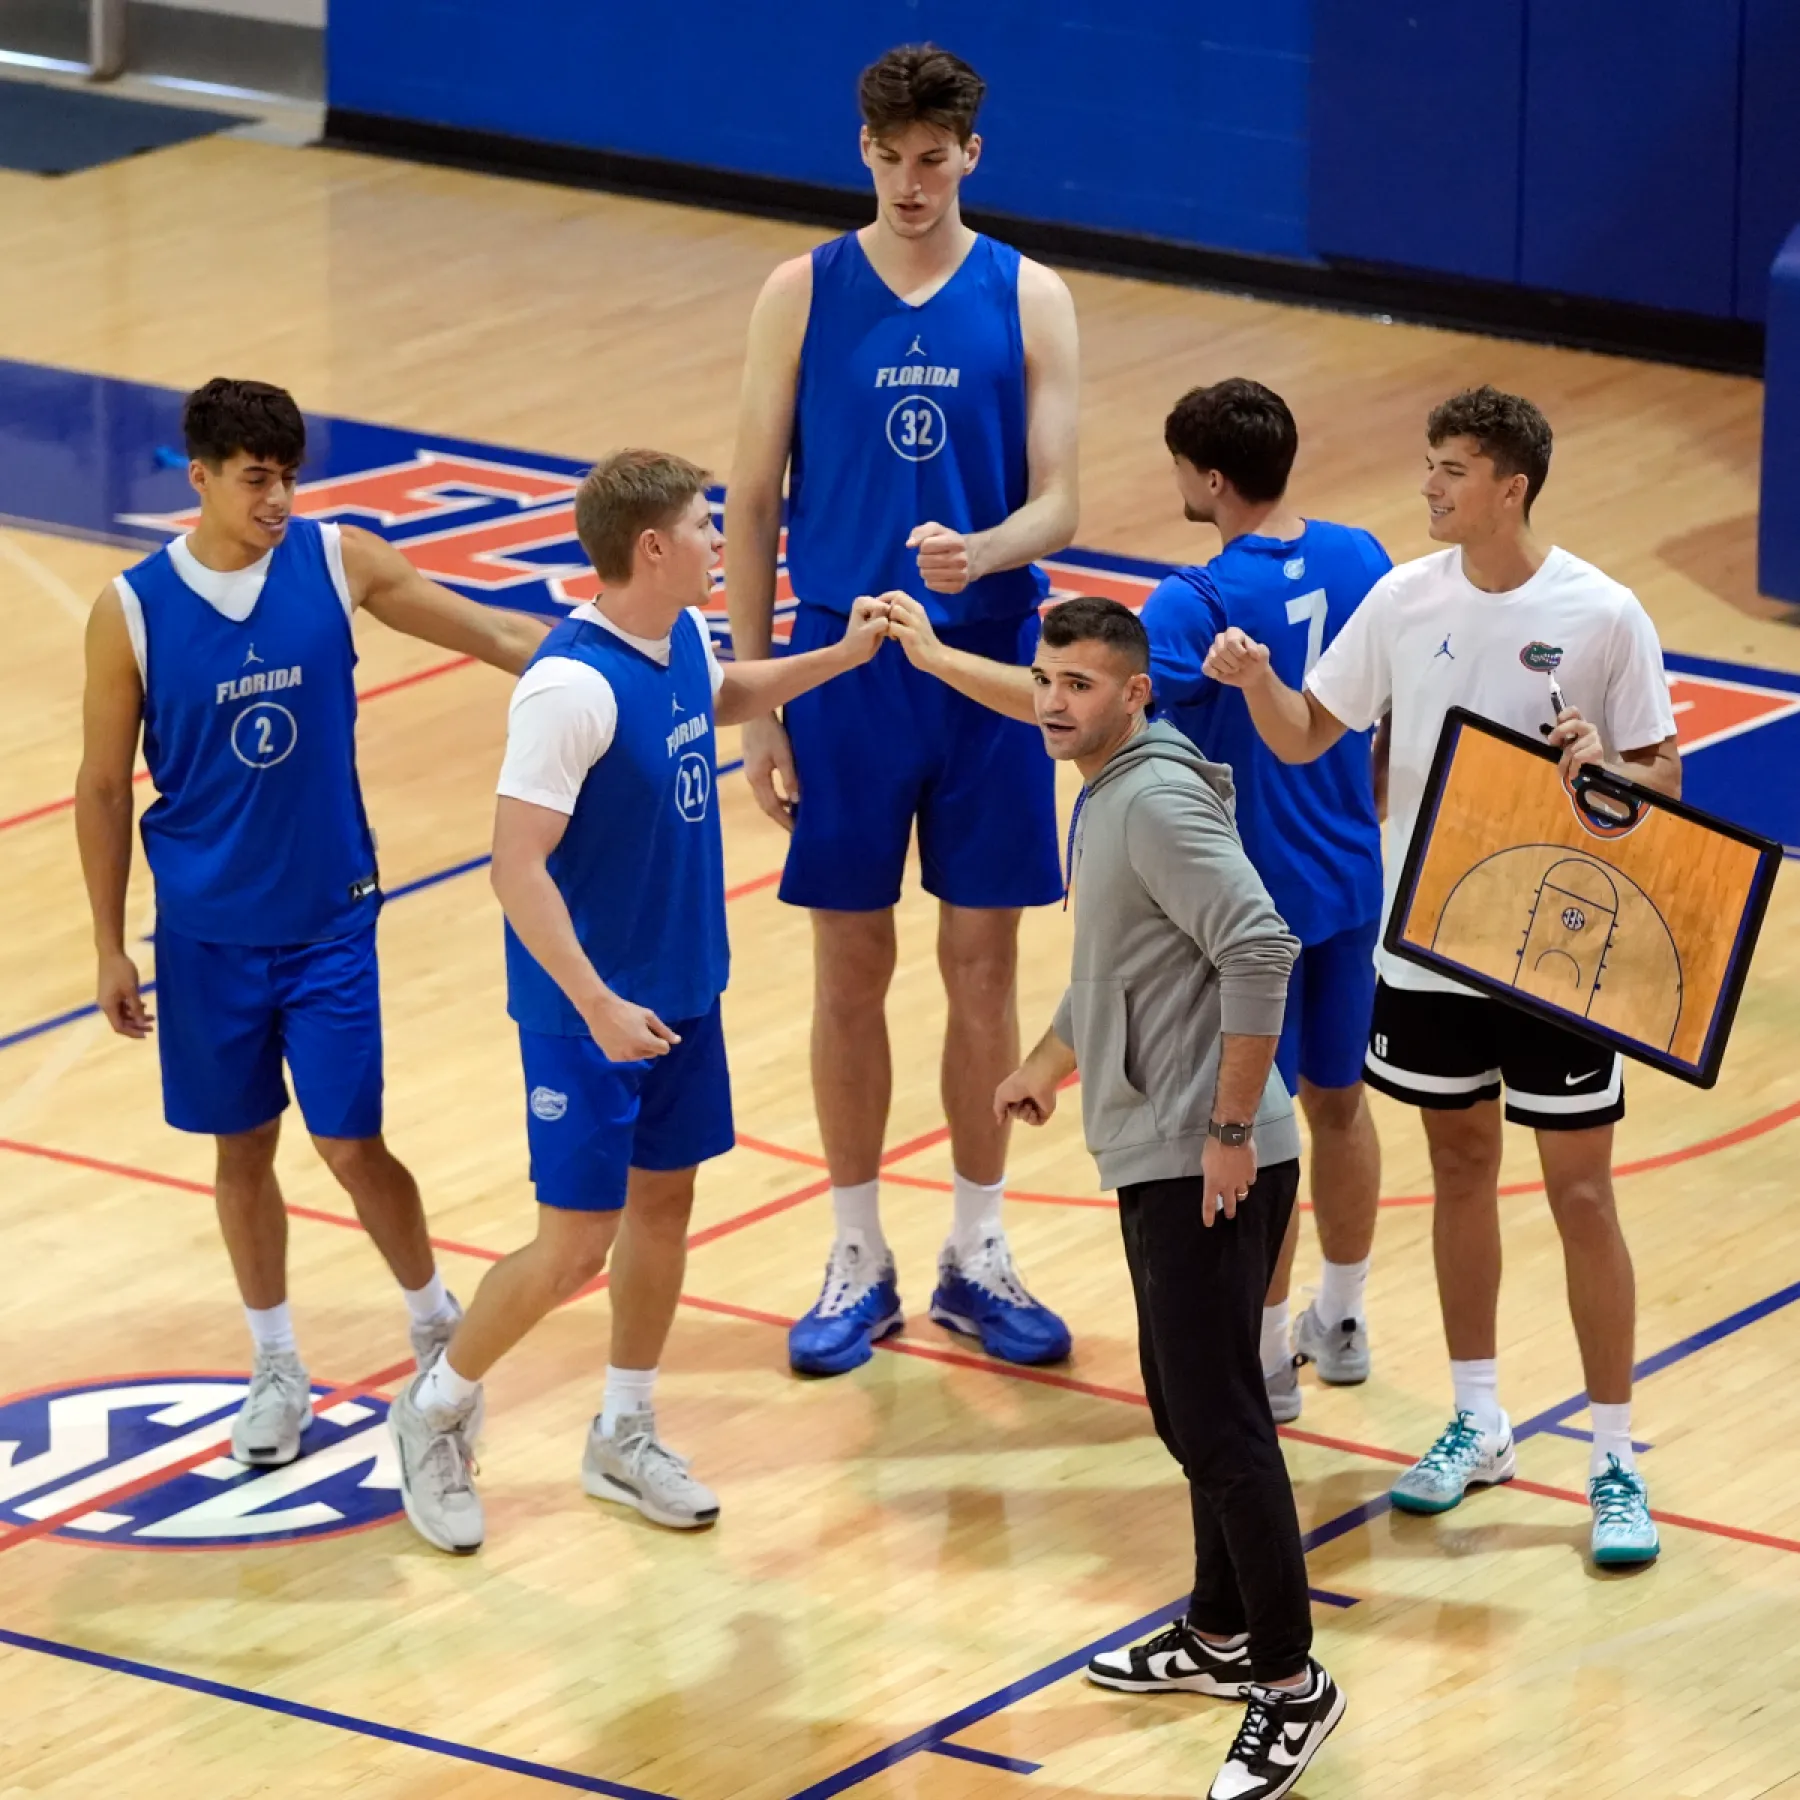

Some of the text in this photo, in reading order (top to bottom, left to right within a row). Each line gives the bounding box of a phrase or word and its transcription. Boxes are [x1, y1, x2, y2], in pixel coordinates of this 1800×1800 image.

[874, 365, 960, 388] FLORIDA
[901, 408, 934, 446] 32
[1284, 587, 1328, 692] 7
[215, 665, 302, 705] FLORIDA
[254, 716, 274, 754] 2
